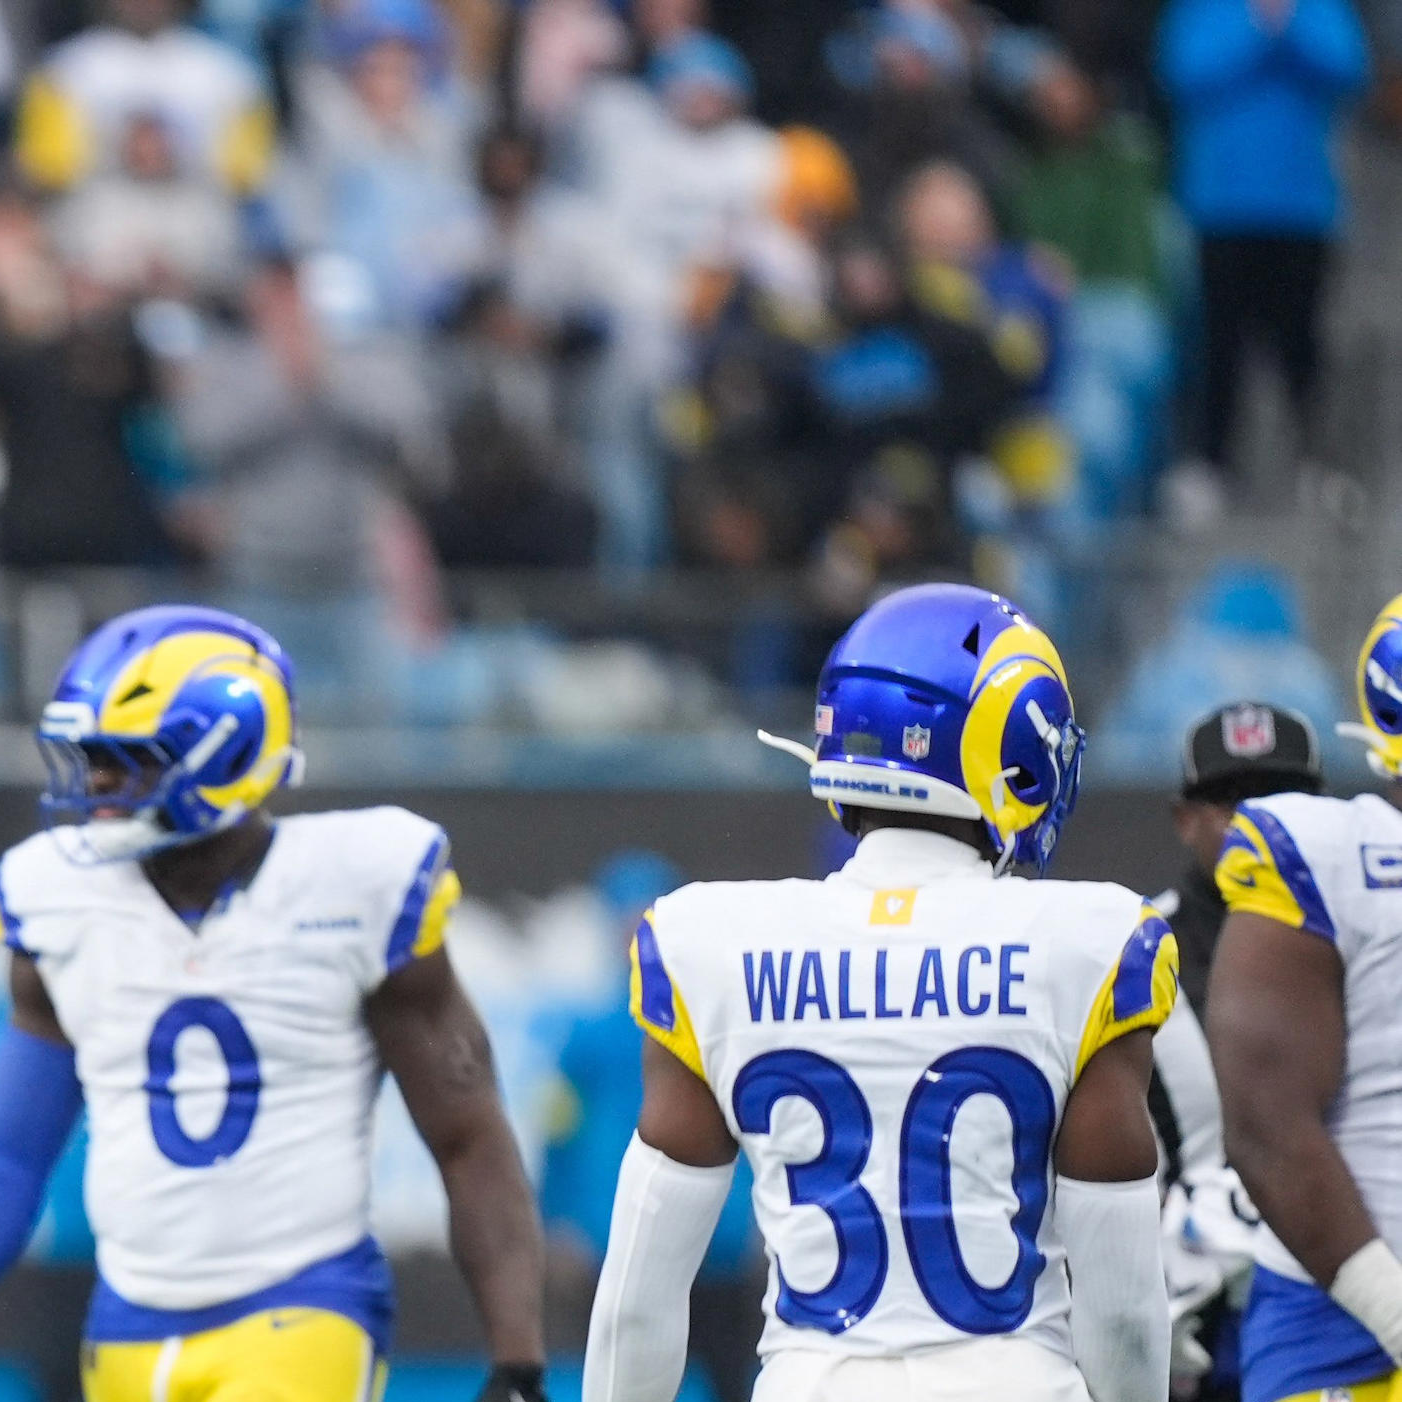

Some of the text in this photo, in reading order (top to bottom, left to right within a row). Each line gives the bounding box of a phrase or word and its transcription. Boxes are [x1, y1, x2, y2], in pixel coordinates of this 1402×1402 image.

[742, 944, 1030, 1023] WALLACE
[145, 994, 262, 1168] 0
[731, 1045, 1056, 1335] 30
